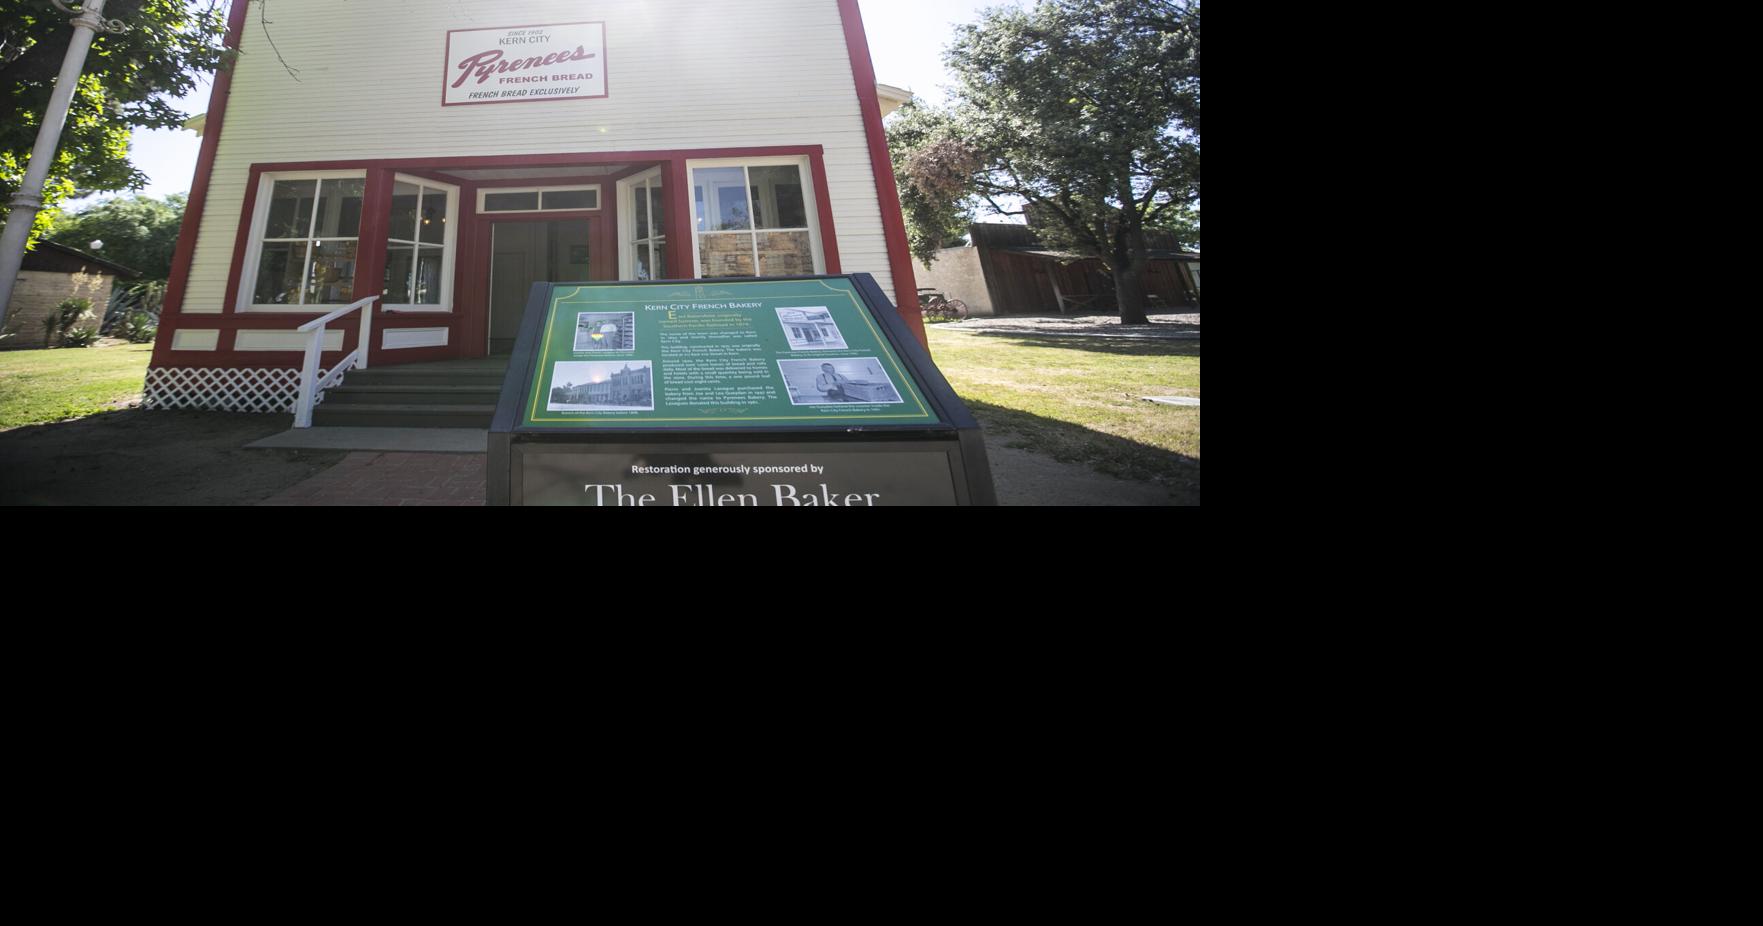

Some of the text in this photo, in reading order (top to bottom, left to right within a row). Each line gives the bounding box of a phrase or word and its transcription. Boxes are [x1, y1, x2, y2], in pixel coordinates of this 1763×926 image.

[499, 35, 551, 45] KERN CITY
[451, 45, 596, 88] Pyrenees
[499, 73, 593, 84] FRENCH BREAD
[468, 91, 499, 99] FRENCH
[530, 86, 581, 96] EXCLUSIVELY
[631, 464, 824, 475] Restoration generously sponsored by
[585, 484, 880, 506] The Ellen Baker
